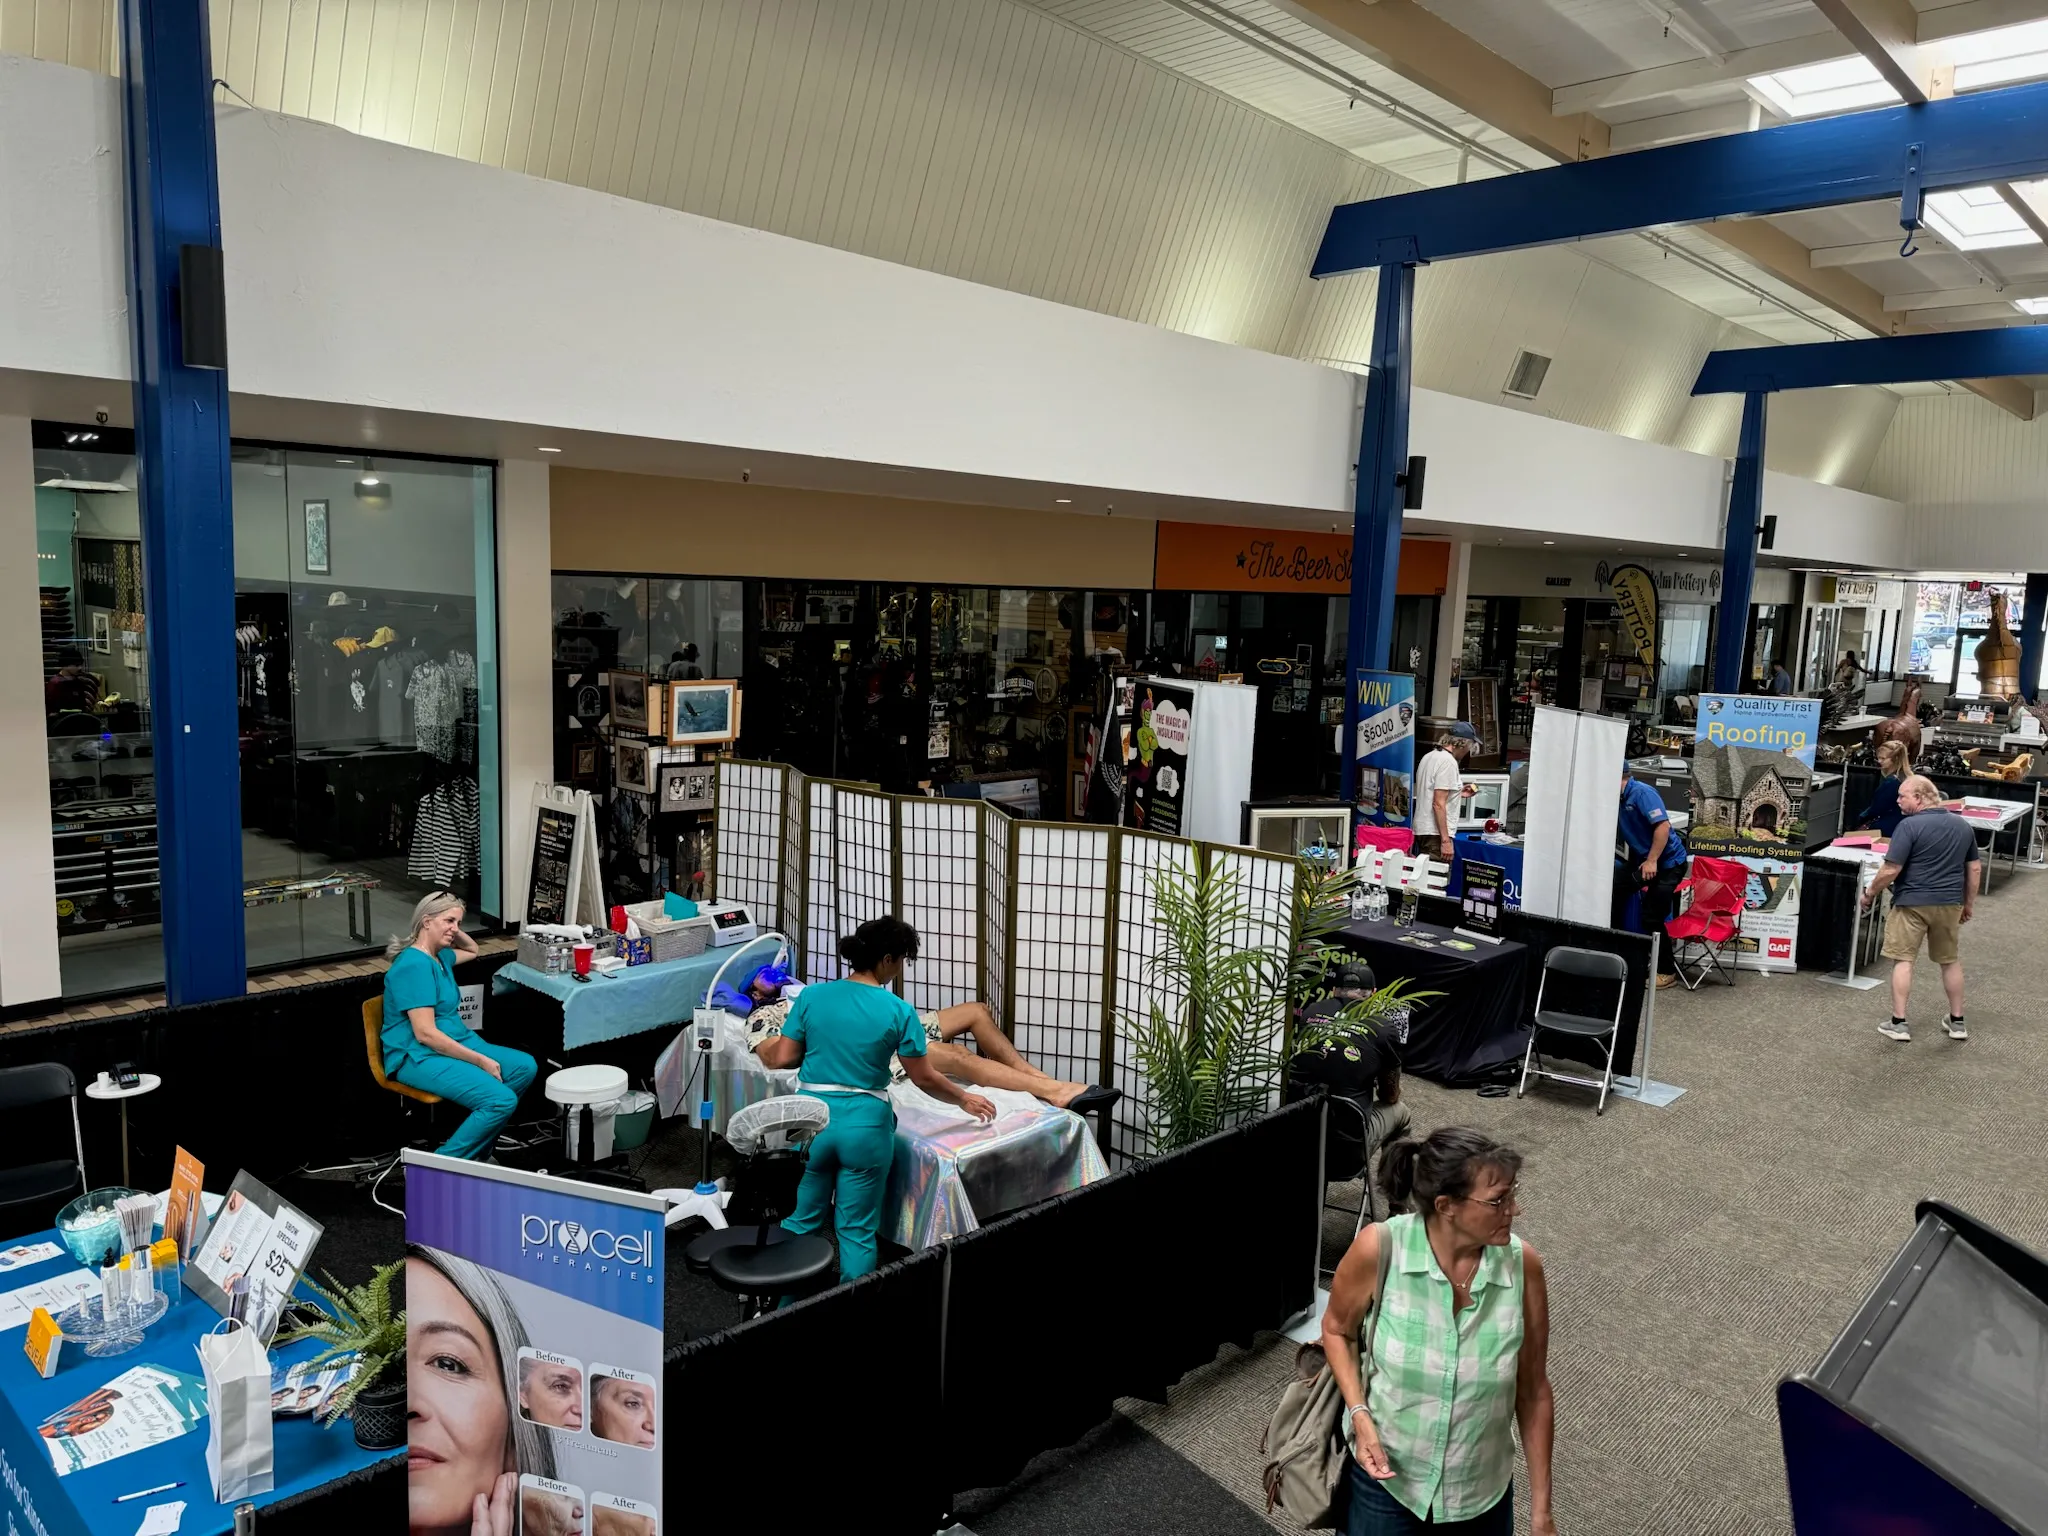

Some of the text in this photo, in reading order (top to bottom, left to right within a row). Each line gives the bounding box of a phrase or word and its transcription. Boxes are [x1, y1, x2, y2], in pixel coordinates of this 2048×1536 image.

[1248, 540, 1286, 580] The
[1286, 546, 1334, 582] Beer
[1673, 572, 1707, 596] Pottery
[1358, 680, 1391, 708] WIN!
[1733, 698, 1812, 712] Quality First
[1964, 704, 1990, 712] SALE
[1156, 714, 1188, 729] THE MAGIC IN
[1364, 718, 1394, 744] $5000
[1157, 727, 1184, 742] INSULATION
[1708, 722, 1806, 750] Roofing
[1690, 841, 1802, 858] Lifetime Roofing System
[1769, 942, 1790, 952] GAF
[284, 1221, 300, 1237] SHOW
[277, 1230, 298, 1252] SPECIALS
[521, 1213, 654, 1268] procell
[264, 1247, 286, 1277] $25
[522, 1248, 655, 1284] THERAPIES
[535, 1350, 566, 1365] Before
[610, 1367, 635, 1381] After
[564, 1436, 618, 1458] Treatments
[14, 1468, 23, 1507] for
[537, 1477, 568, 1493] Before
[612, 1496, 637, 1510] After
